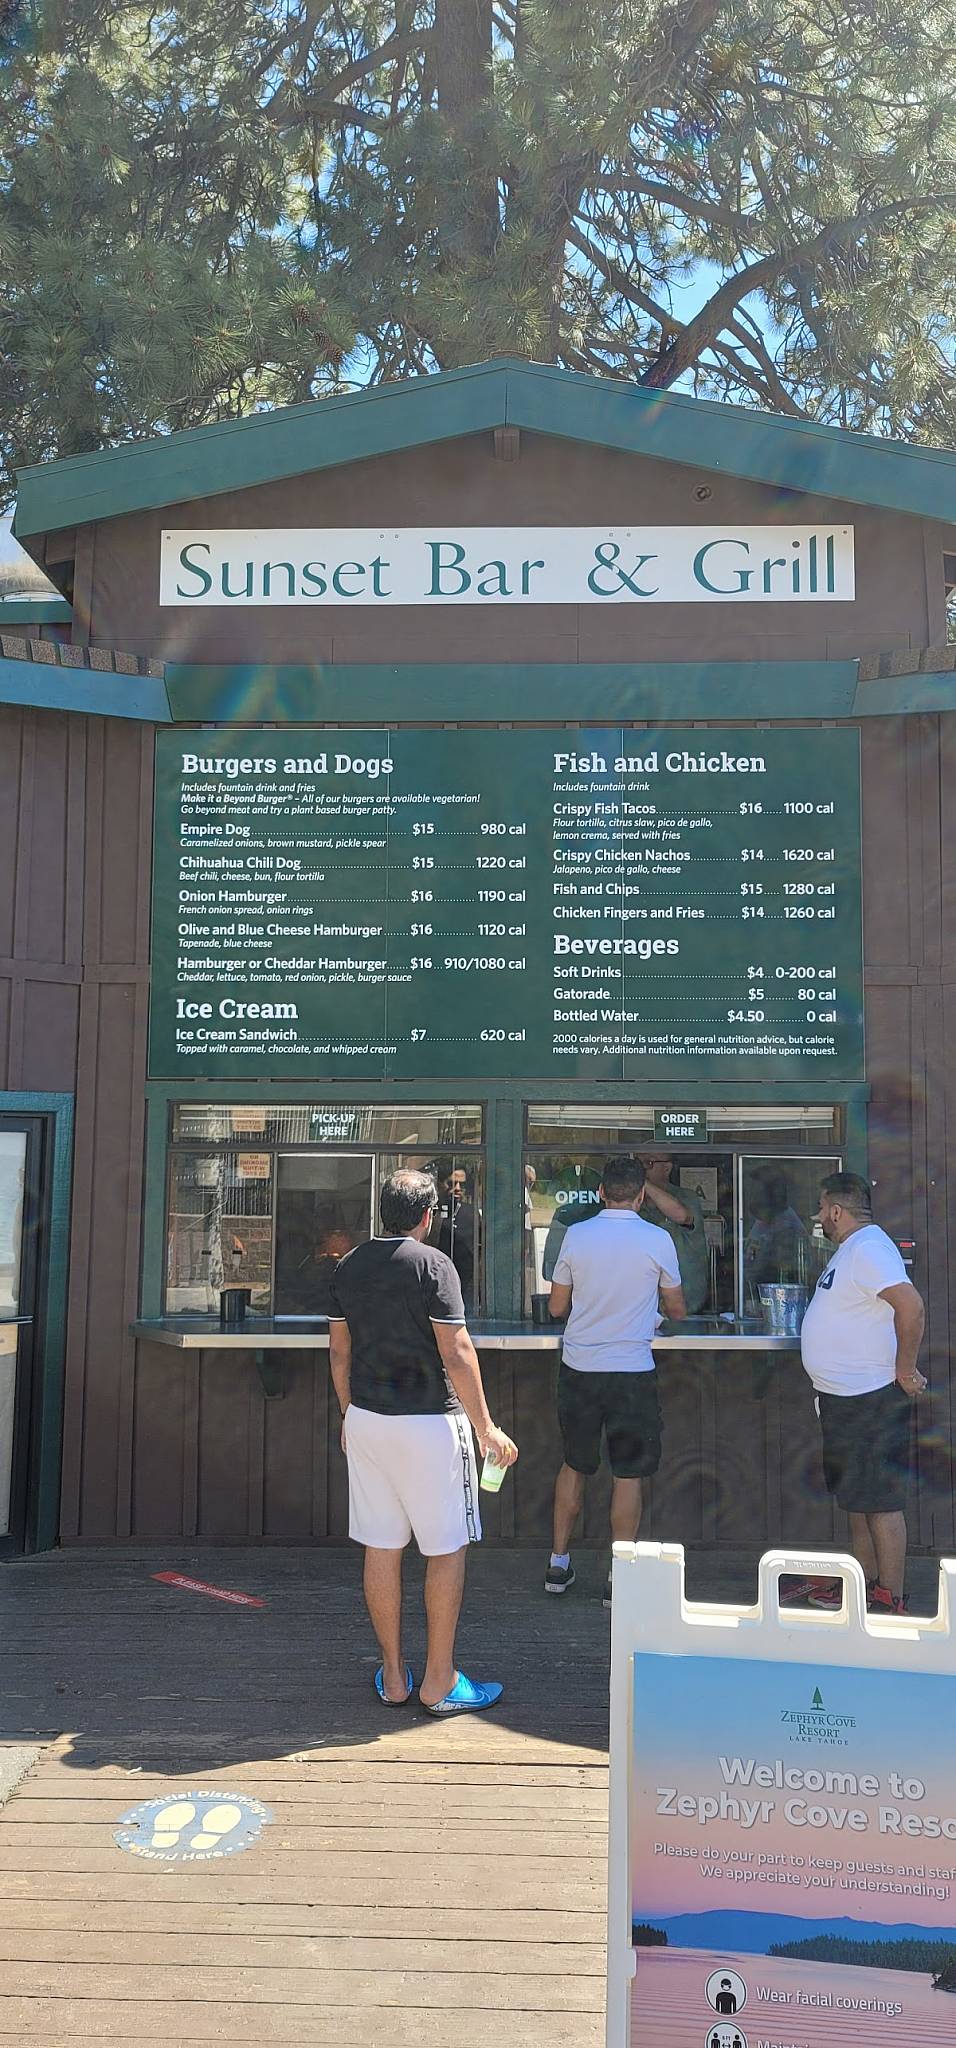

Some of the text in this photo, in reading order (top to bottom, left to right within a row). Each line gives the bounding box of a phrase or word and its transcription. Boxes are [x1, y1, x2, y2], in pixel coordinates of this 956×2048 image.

[176, 535, 836, 599] Sunset Bar & Grill
[181, 753, 393, 781] Burgers and Dogs
[554, 750, 767, 773] Fish and Chicken
[181, 782, 316, 794] Includes fountain drink and fries
[553, 781, 650, 793] Includes fountain drink
[553, 802, 834, 817] Crispy Fish Tacos $16 1100 cal
[181, 823, 526, 838] Empire Dog $15 980 cal
[180, 838, 387, 849] Caramelized onions, brown mustard, pickle spear
[553, 848, 834, 863] Crispy Chicken Nachos $14 1620 cal
[180, 856, 526, 871] Chihuahua Chili Dog $15 1220 cal
[179, 890, 526, 904] Onion Hamburger $16 1190 cal
[554, 882, 835, 897] Fish and Chips $15 1280 cal
[553, 905, 835, 921] Chicken Fingers and Fries $14 1260 cal
[178, 923, 526, 938] Olive and Blue Cheese Hamburger $16 1120 cal
[554, 935, 679, 960] Beverages
[178, 957, 525, 972] Hamburger or Cheddar Hamburger $16 910/1080 cal
[554, 966, 836, 980] Soft Drinks $4 0-200 cal
[554, 988, 836, 1002] Gatorade $5 80 cal
[176, 999, 298, 1019] Ice Cream
[554, 1009, 837, 1024] Bottled Water $4.50 0 cal
[176, 1028, 525, 1042] Ice Cream Sandwich $7 620 cal
[553, 1045, 838, 1056] needs vary. Additional nutrition information available upon request.
[312, 1113, 355, 1123] PICK-UP
[661, 1114, 700, 1123] ORDER
[319, 1126, 348, 1136] HERE
[665, 1126, 695, 1136] HERE
[555, 1190, 600, 1204] OPEN
[818, 1738, 848, 1746] TAHOE
[718, 1756, 925, 1800] Welcome to
[144, 1790, 266, 1814] Social Distancing
[655, 1787, 775, 1828] Zephyr
[784, 1798, 868, 1831] Cove
[654, 1842, 698, 1858] Please
[702, 1846, 720, 1859] do
[722, 1849, 754, 1863] your
[758, 1853, 787, 1865] part
[790, 1854, 804, 1866] to
[808, 1855, 843, 1872] keep
[847, 1861, 894, 1874] guests
[897, 1865, 925, 1878] and
[699, 1863, 950, 1900] We appreciate your understanding!
[756, 1986, 902, 2016] Wear facial coverings
